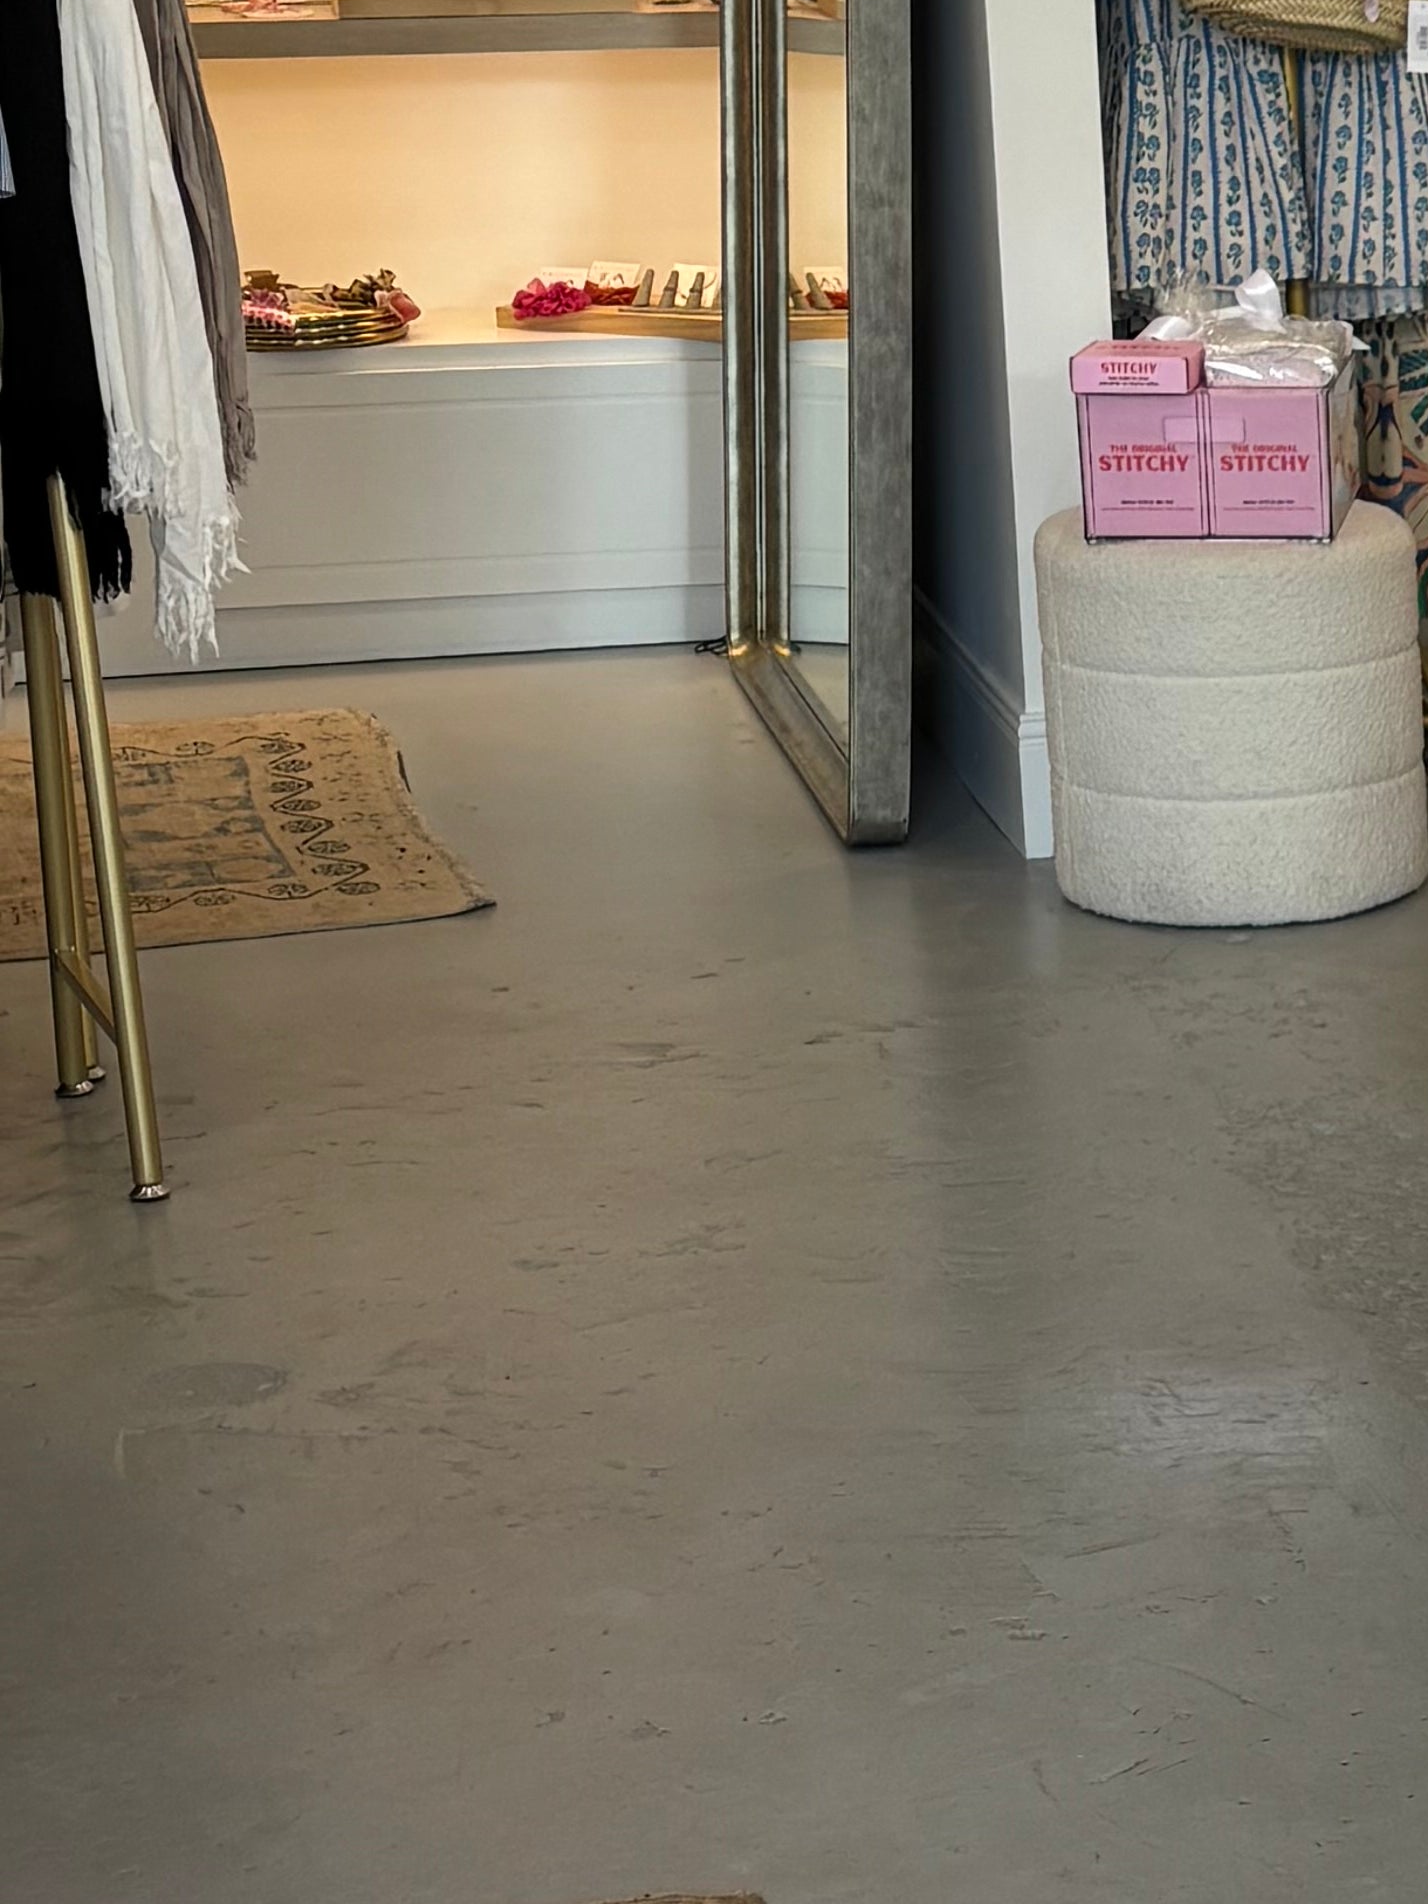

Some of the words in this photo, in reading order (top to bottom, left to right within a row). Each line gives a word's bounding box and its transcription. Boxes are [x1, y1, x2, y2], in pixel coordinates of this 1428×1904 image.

[1100, 361, 1158, 376] STITCHY
[1098, 454, 1190, 472] STITCHY
[1220, 454, 1311, 472] STITCHY
